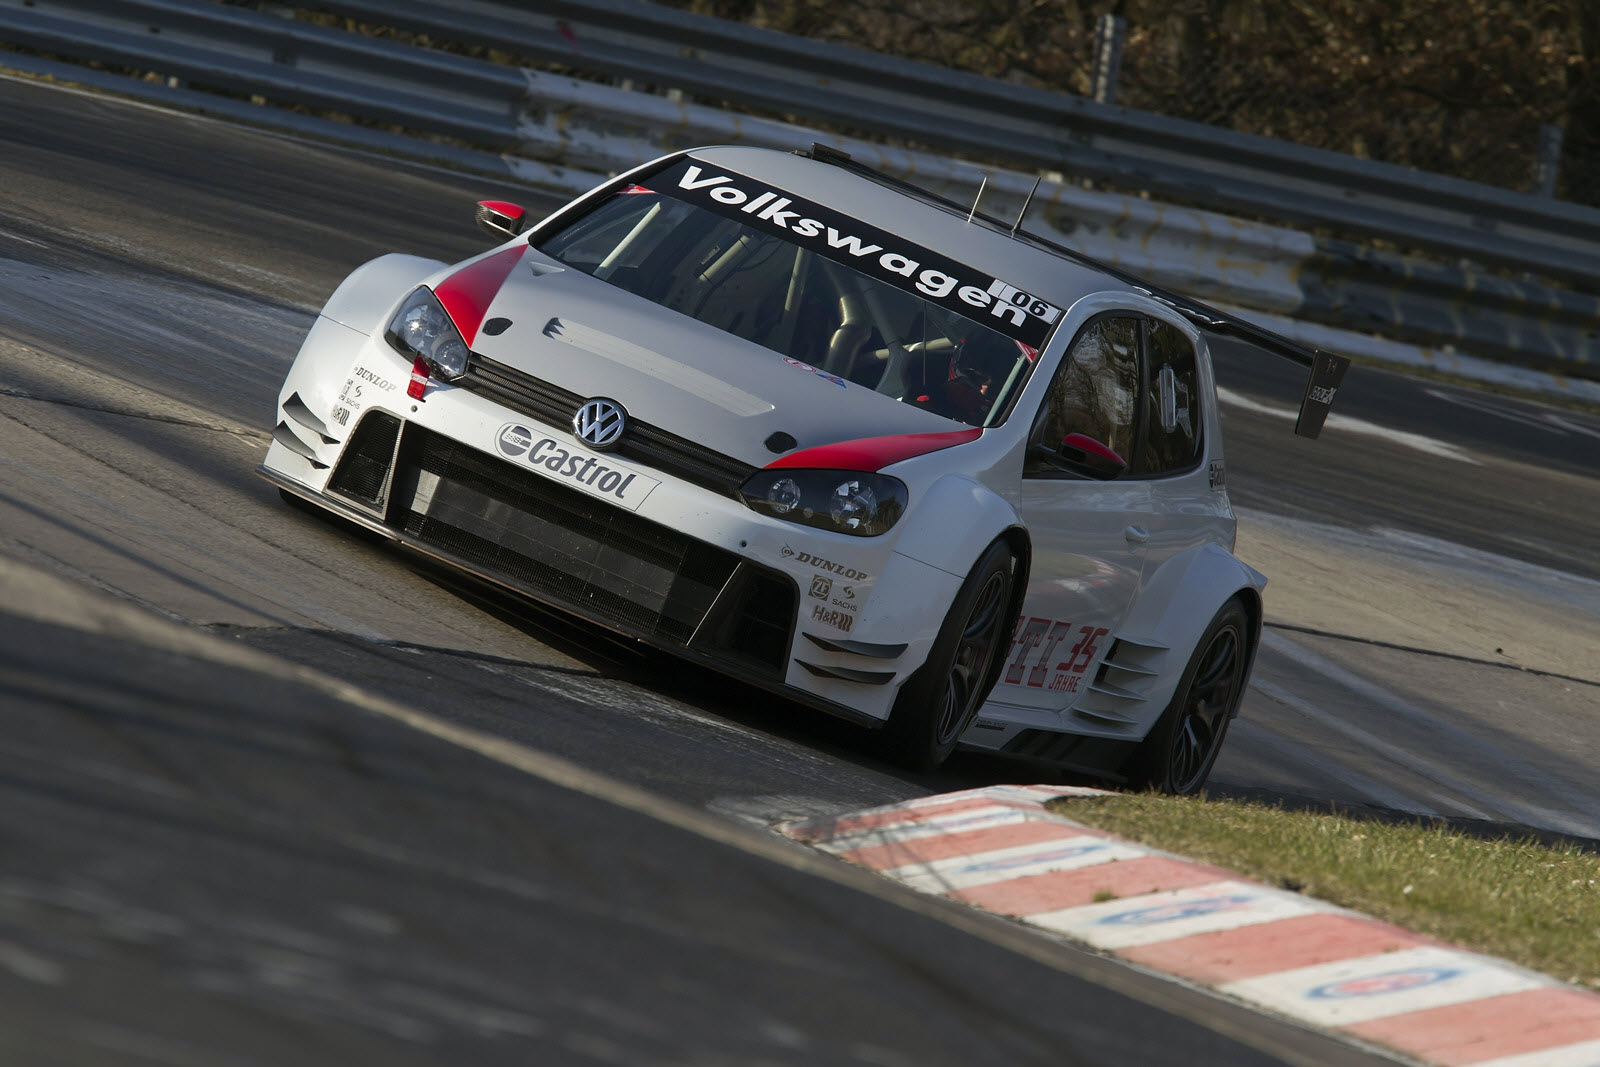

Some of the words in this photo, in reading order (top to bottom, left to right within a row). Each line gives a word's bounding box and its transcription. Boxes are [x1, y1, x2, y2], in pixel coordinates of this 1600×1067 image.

[677, 165, 1027, 327] Volkswagen
[1011, 291, 1049, 316] 06
[355, 367, 397, 392] DUNLOP
[528, 438, 637, 499] Castrol
[795, 551, 868, 581] DUNLOP
[832, 598, 857, 611] SACHS
[1005, 615, 1072, 688] TI
[1056, 626, 1111, 673] 35
[1048, 673, 1082, 693] JAHRE
